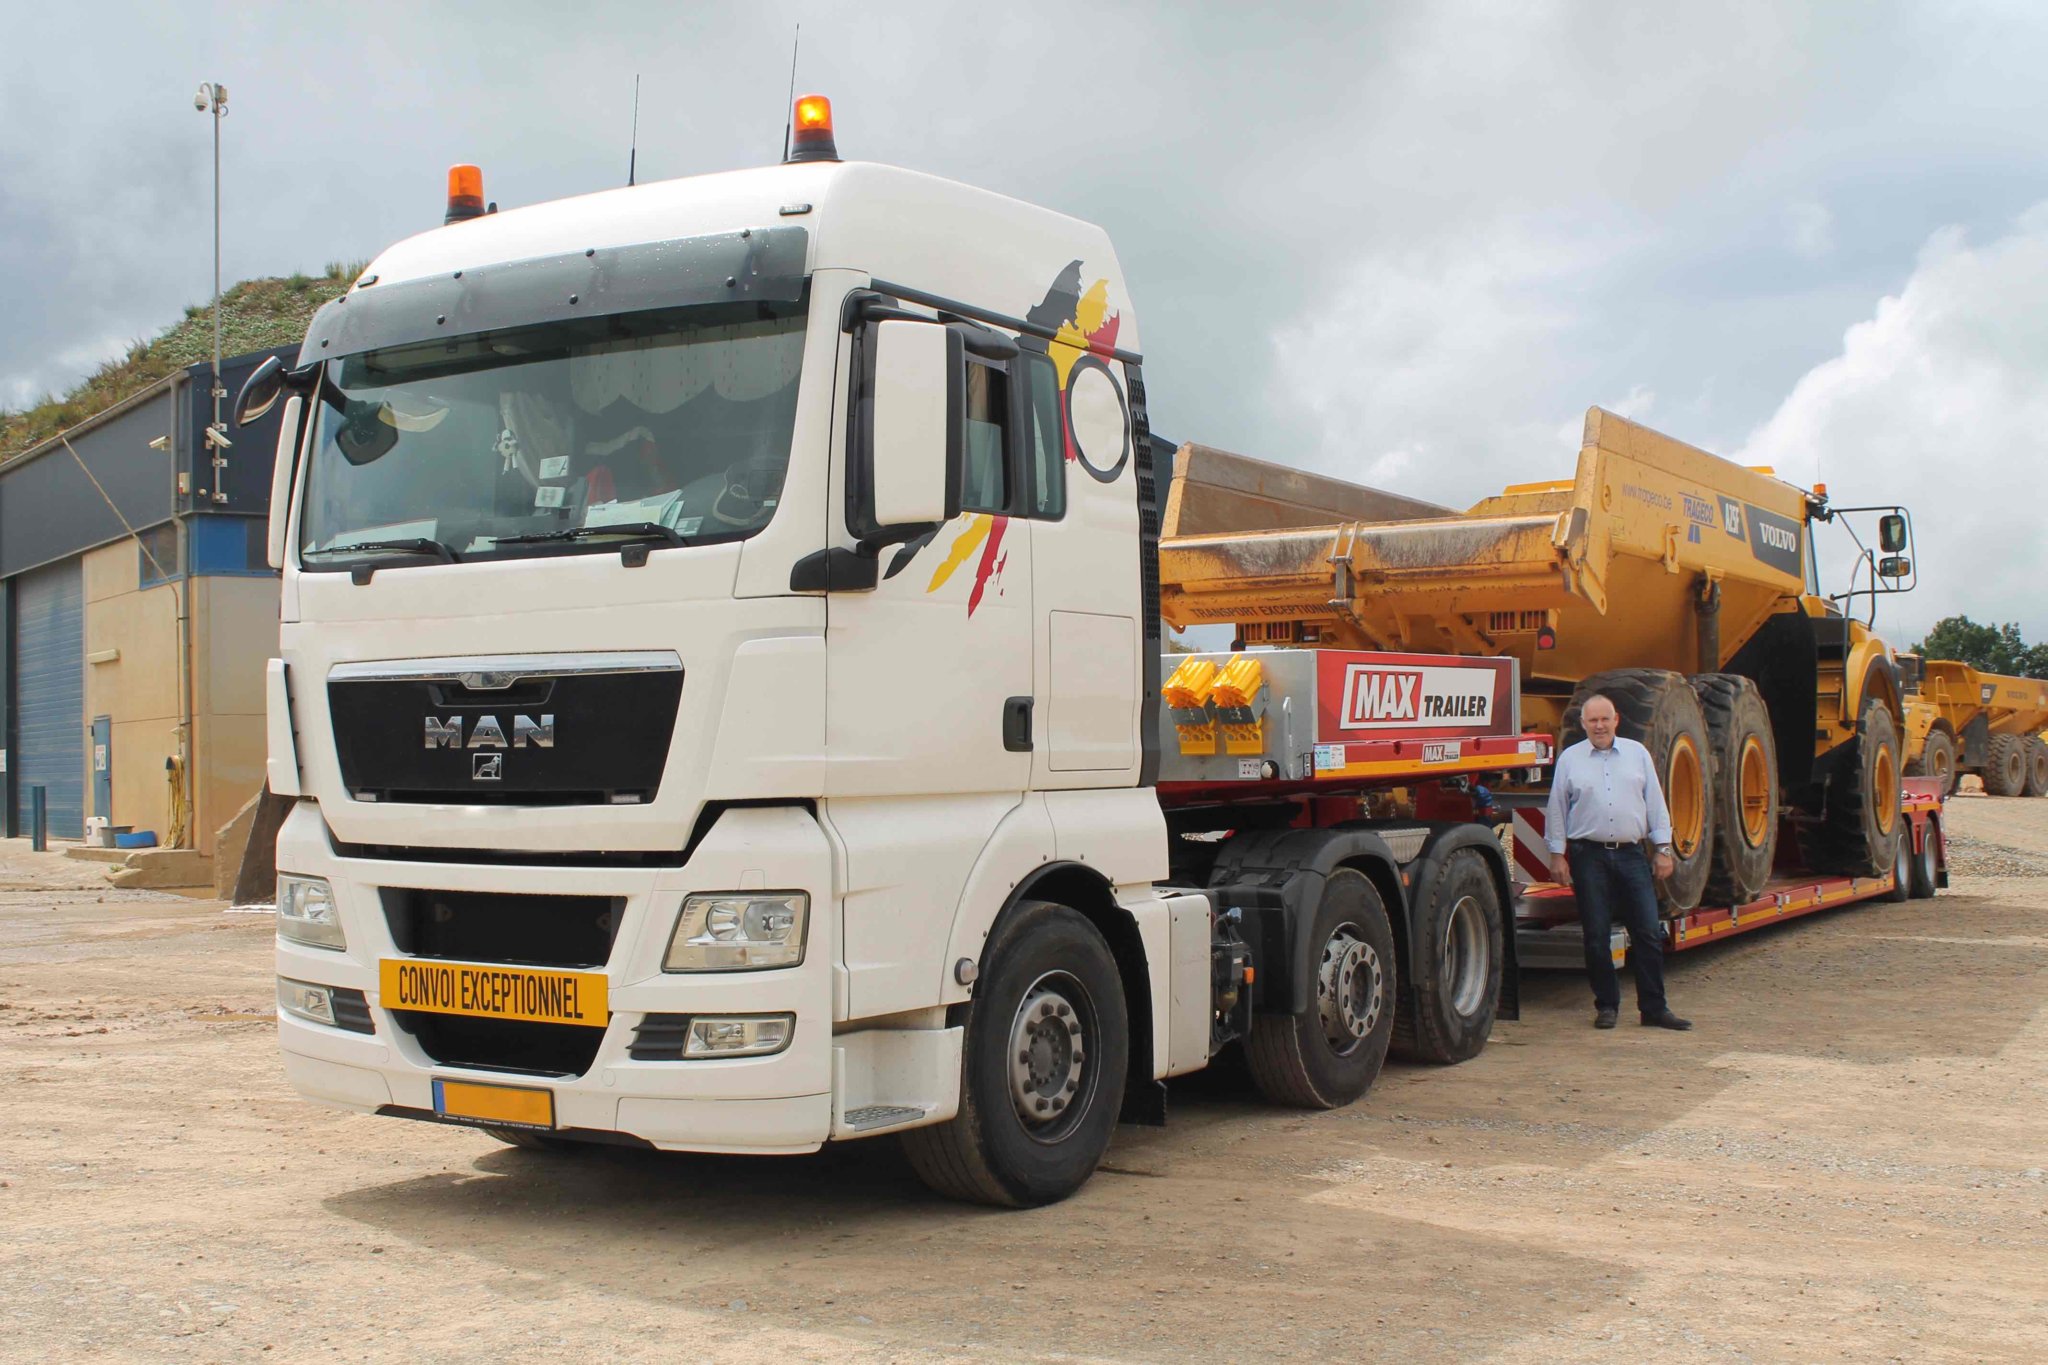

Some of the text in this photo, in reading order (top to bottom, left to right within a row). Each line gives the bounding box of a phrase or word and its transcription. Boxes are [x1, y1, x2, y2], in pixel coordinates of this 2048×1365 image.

[1683, 498, 1714, 524] TRAGECO
[1759, 522, 1796, 552] VOLVO
[1189, 606, 1258, 618] TRANSPORT
[1354, 673, 1487, 720] MAX TRAILER
[425, 714, 554, 748] MAN
[1424, 745, 1443, 761] MAX
[399, 965, 583, 1018] CONVOI EXCEPTIONNEL
